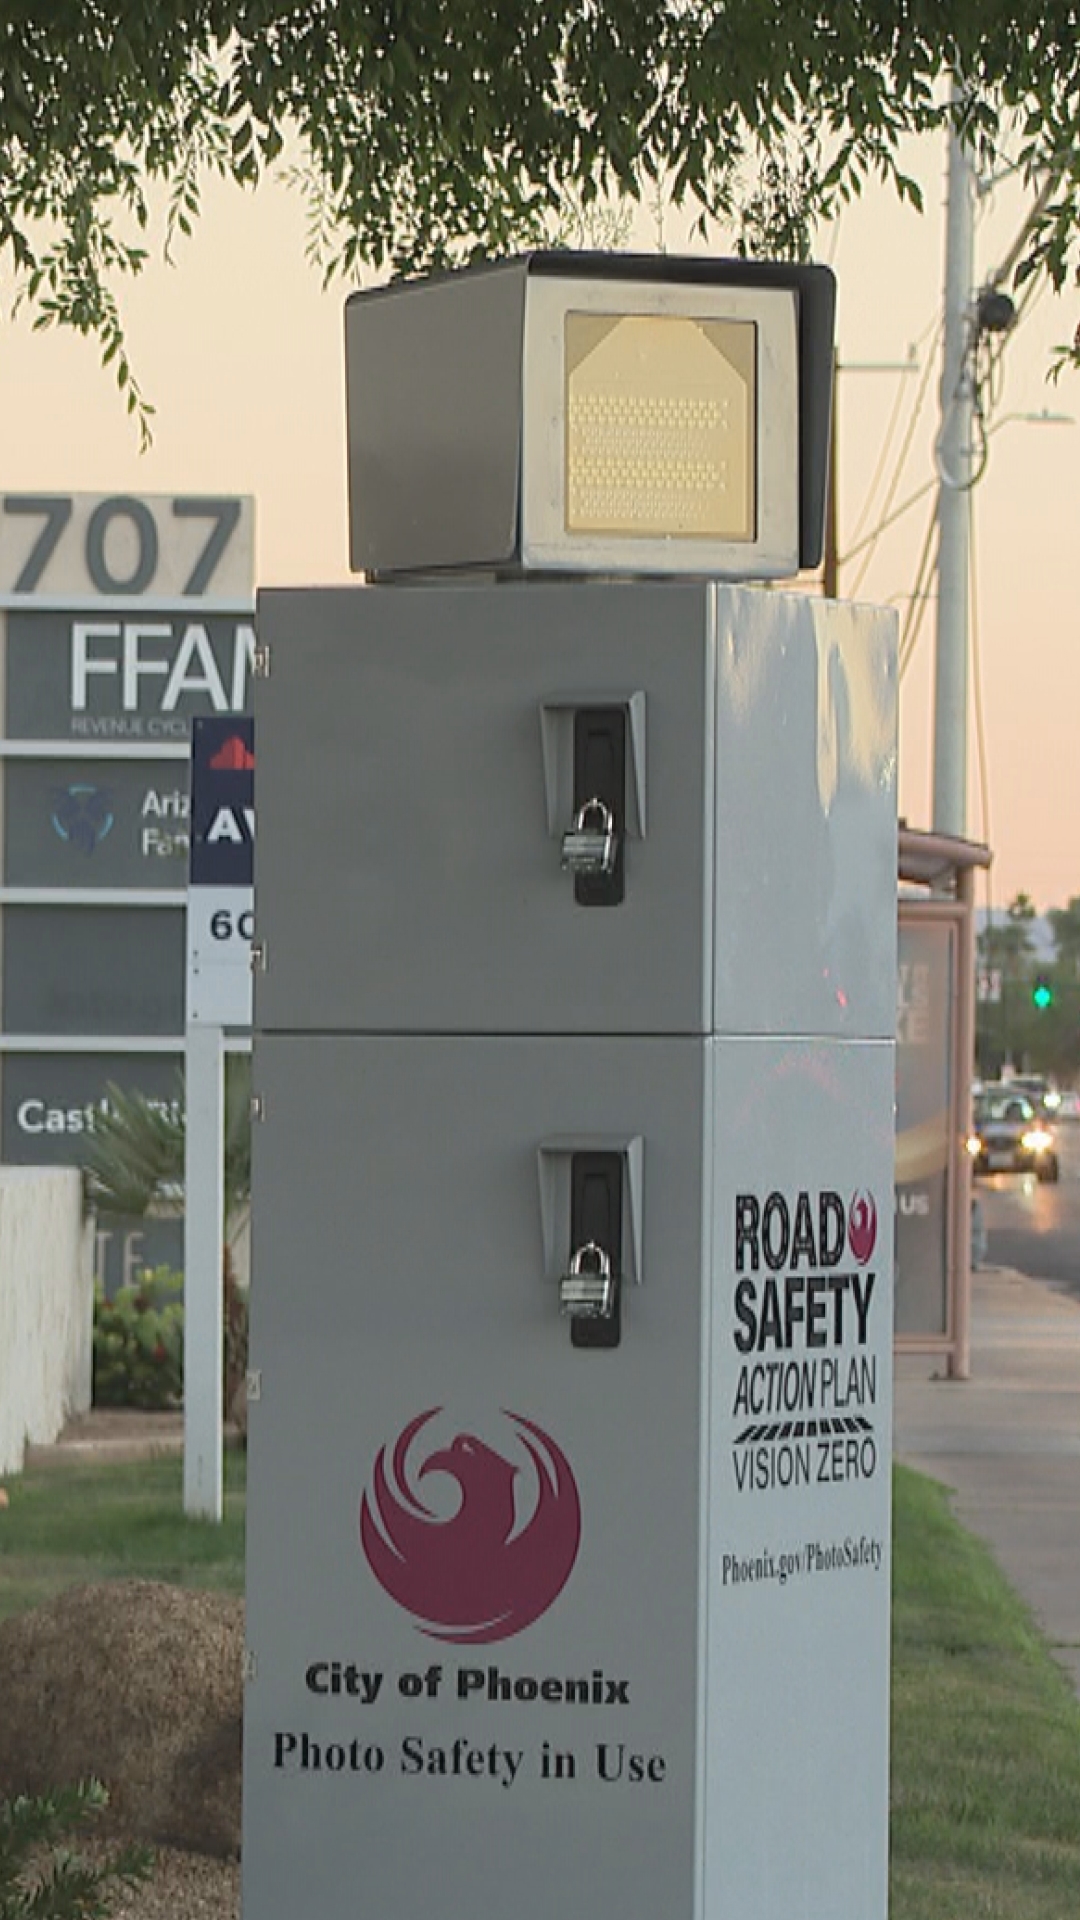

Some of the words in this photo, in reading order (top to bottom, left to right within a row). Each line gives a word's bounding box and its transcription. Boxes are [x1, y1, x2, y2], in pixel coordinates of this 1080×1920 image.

[4, 495, 242, 597] 707
[735, 1191, 846, 1272] ROAD
[733, 1273, 876, 1354] SAFETY
[733, 1359, 817, 1417] ACTION
[821, 1355, 876, 1408] PLAN
[732, 1444, 810, 1493] VISION
[817, 1436, 877, 1483] ZERO
[722, 1535, 882, 1587] Phoenix.gov/PhotoSafety
[305, 1662, 384, 1704] City
[398, 1665, 443, 1698] of
[457, 1666, 631, 1704] Phoenix
[273, 1731, 386, 1773] Photo
[401, 1736, 524, 1788] Safety
[541, 1740, 577, 1779] in
[596, 1743, 667, 1783] Use
